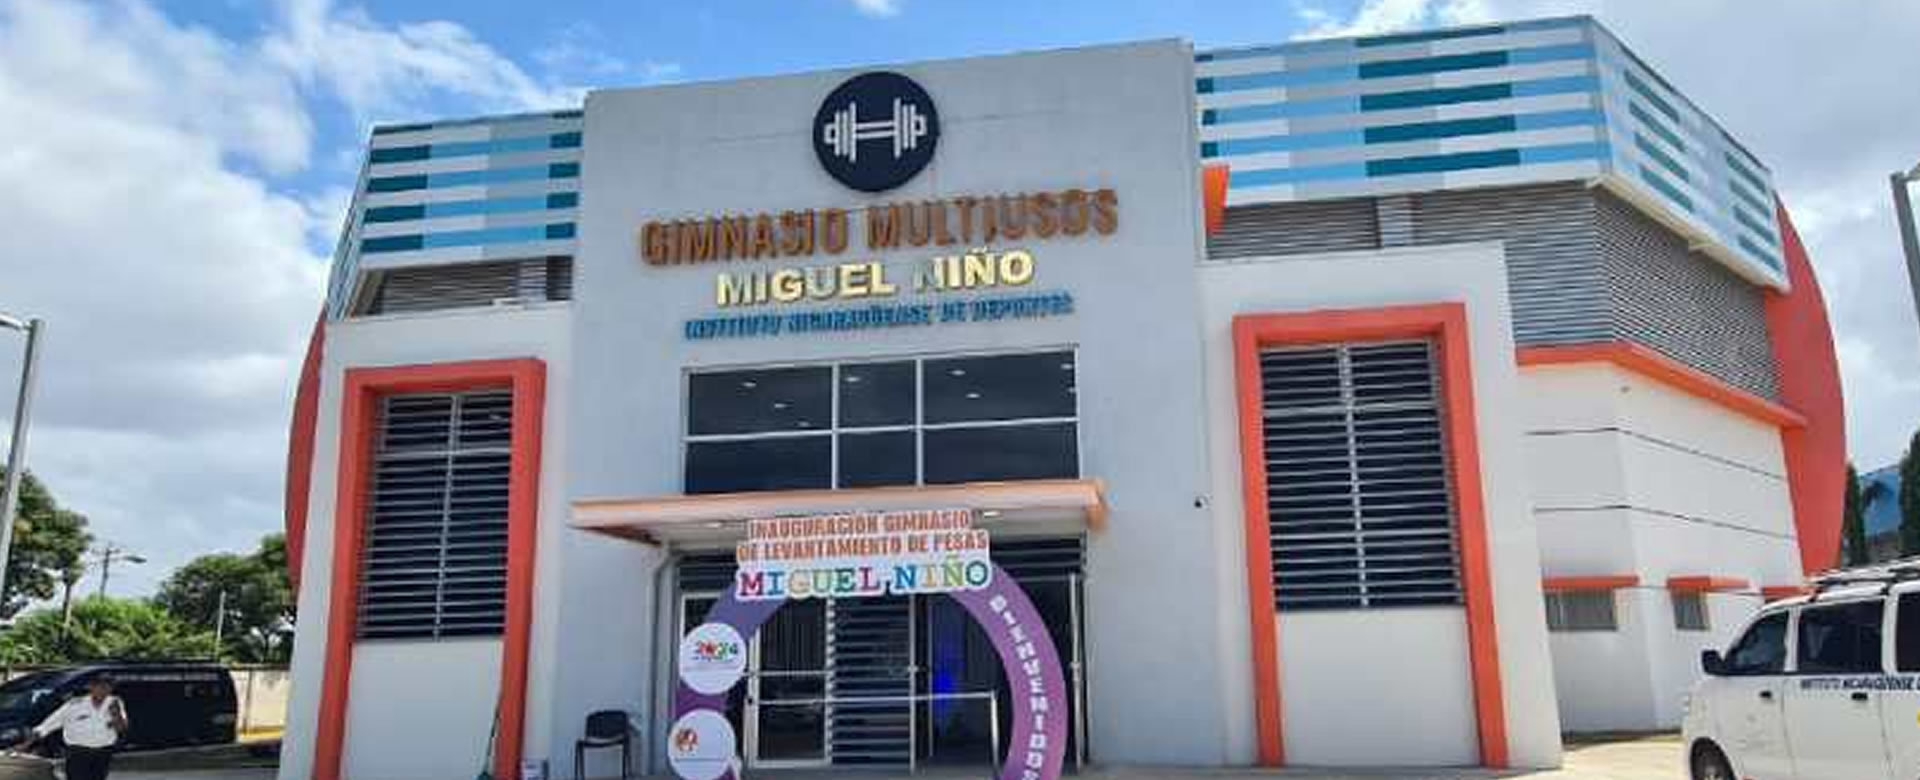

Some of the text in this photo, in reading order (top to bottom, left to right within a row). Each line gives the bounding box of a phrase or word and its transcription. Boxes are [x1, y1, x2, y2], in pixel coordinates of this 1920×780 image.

[640, 188, 1119, 267] GIMNASIO MULTIUSOS
[716, 245, 1036, 305] MIGUEL NIÑO
[751, 510, 969, 539] INAUGURACIÓN GIMNASIO
[739, 530, 986, 562] DE LEVANTAMIENTO DE PESAS
[740, 555, 988, 596] MIGUEL NIÑO
